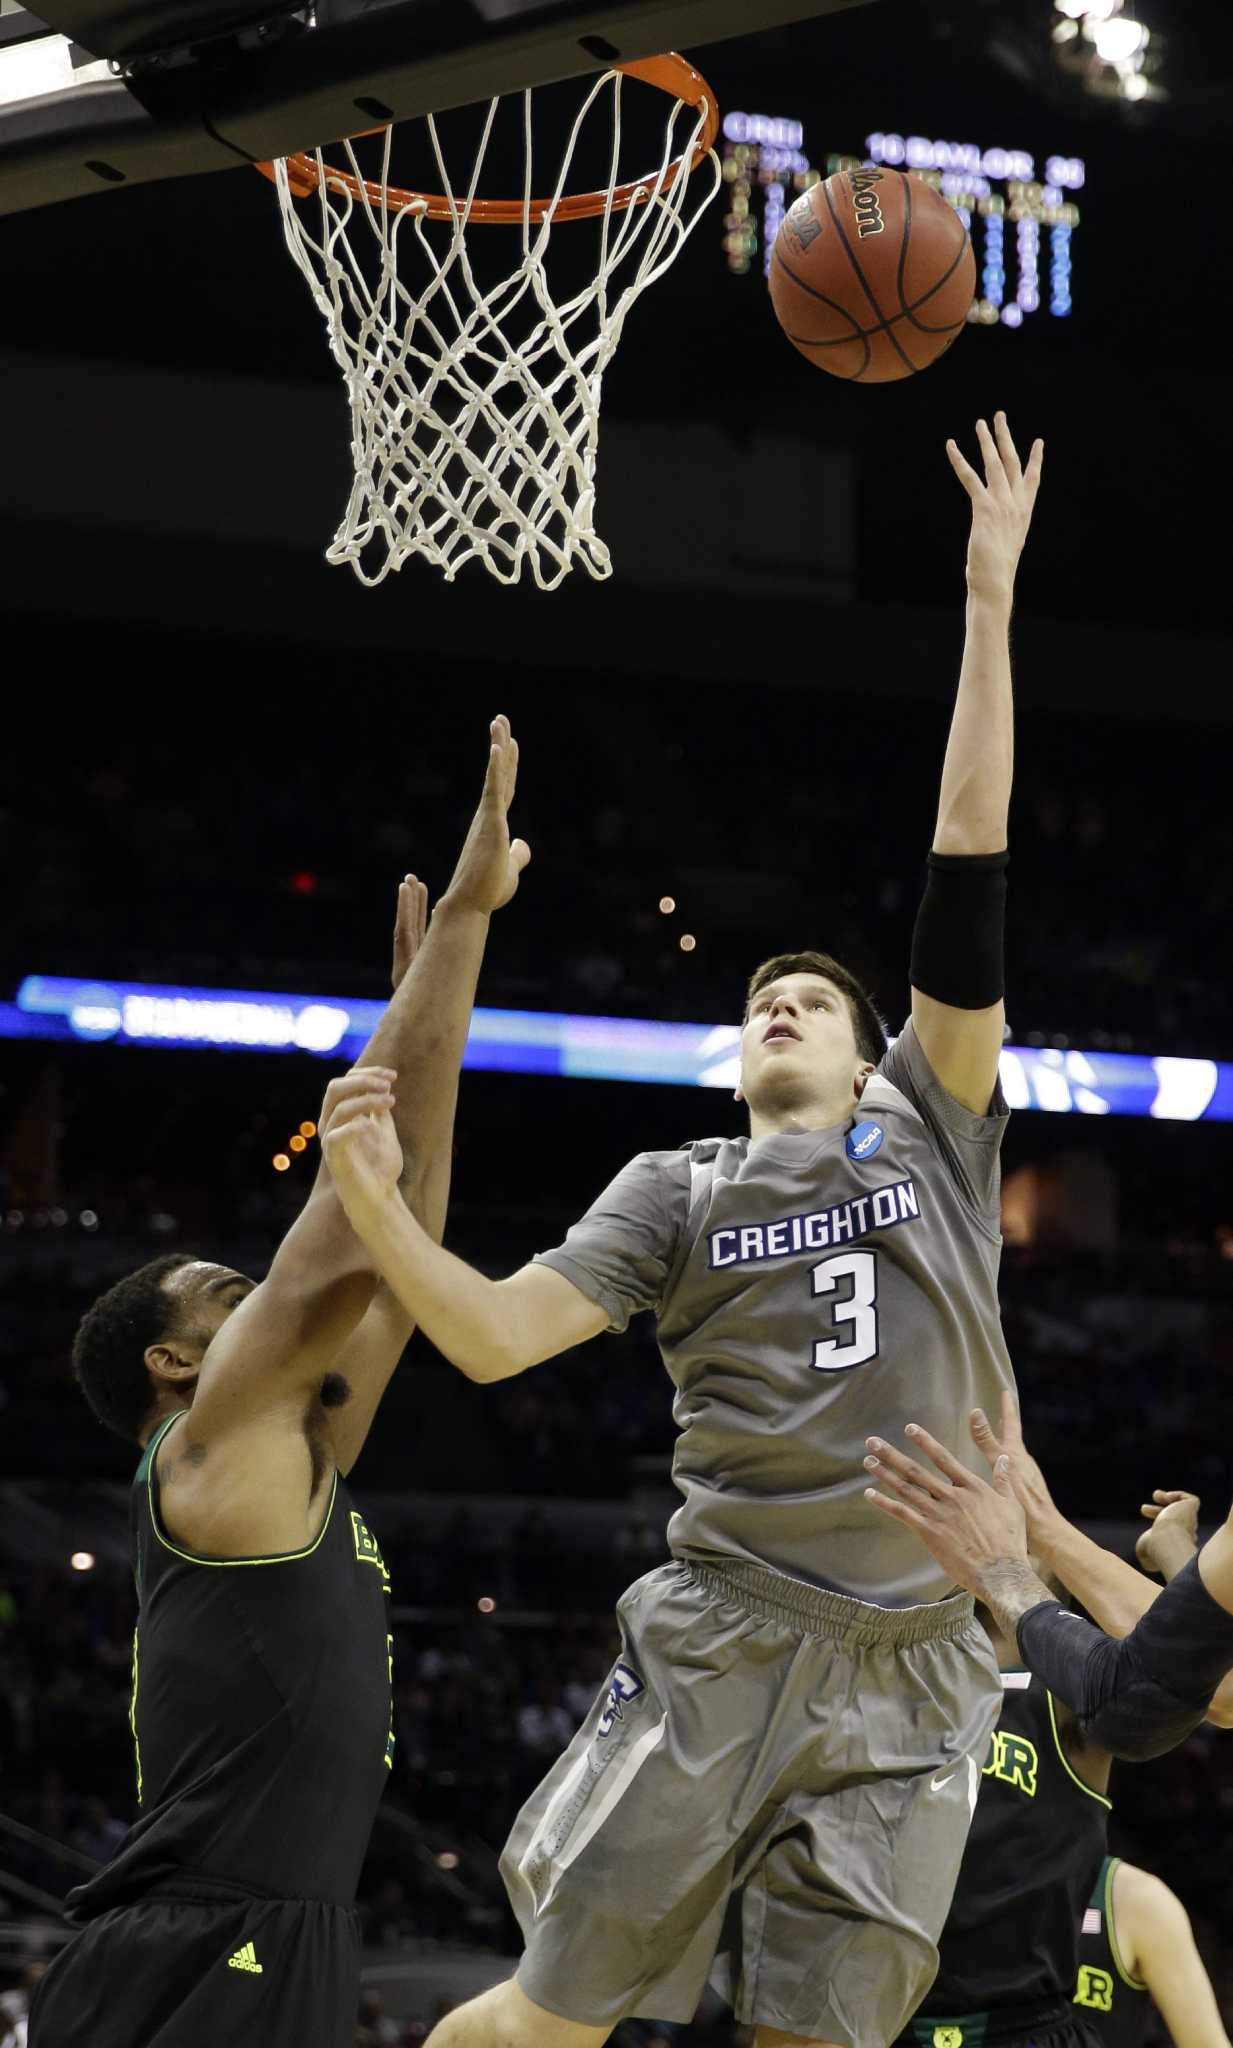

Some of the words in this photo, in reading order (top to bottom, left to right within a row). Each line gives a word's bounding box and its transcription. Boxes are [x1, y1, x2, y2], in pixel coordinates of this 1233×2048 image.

[854, 1127, 882, 1155] NCAA
[709, 1180, 920, 1269] CREIGHTON
[810, 1251, 879, 1372] 3
[228, 1957, 263, 1973] adidas
